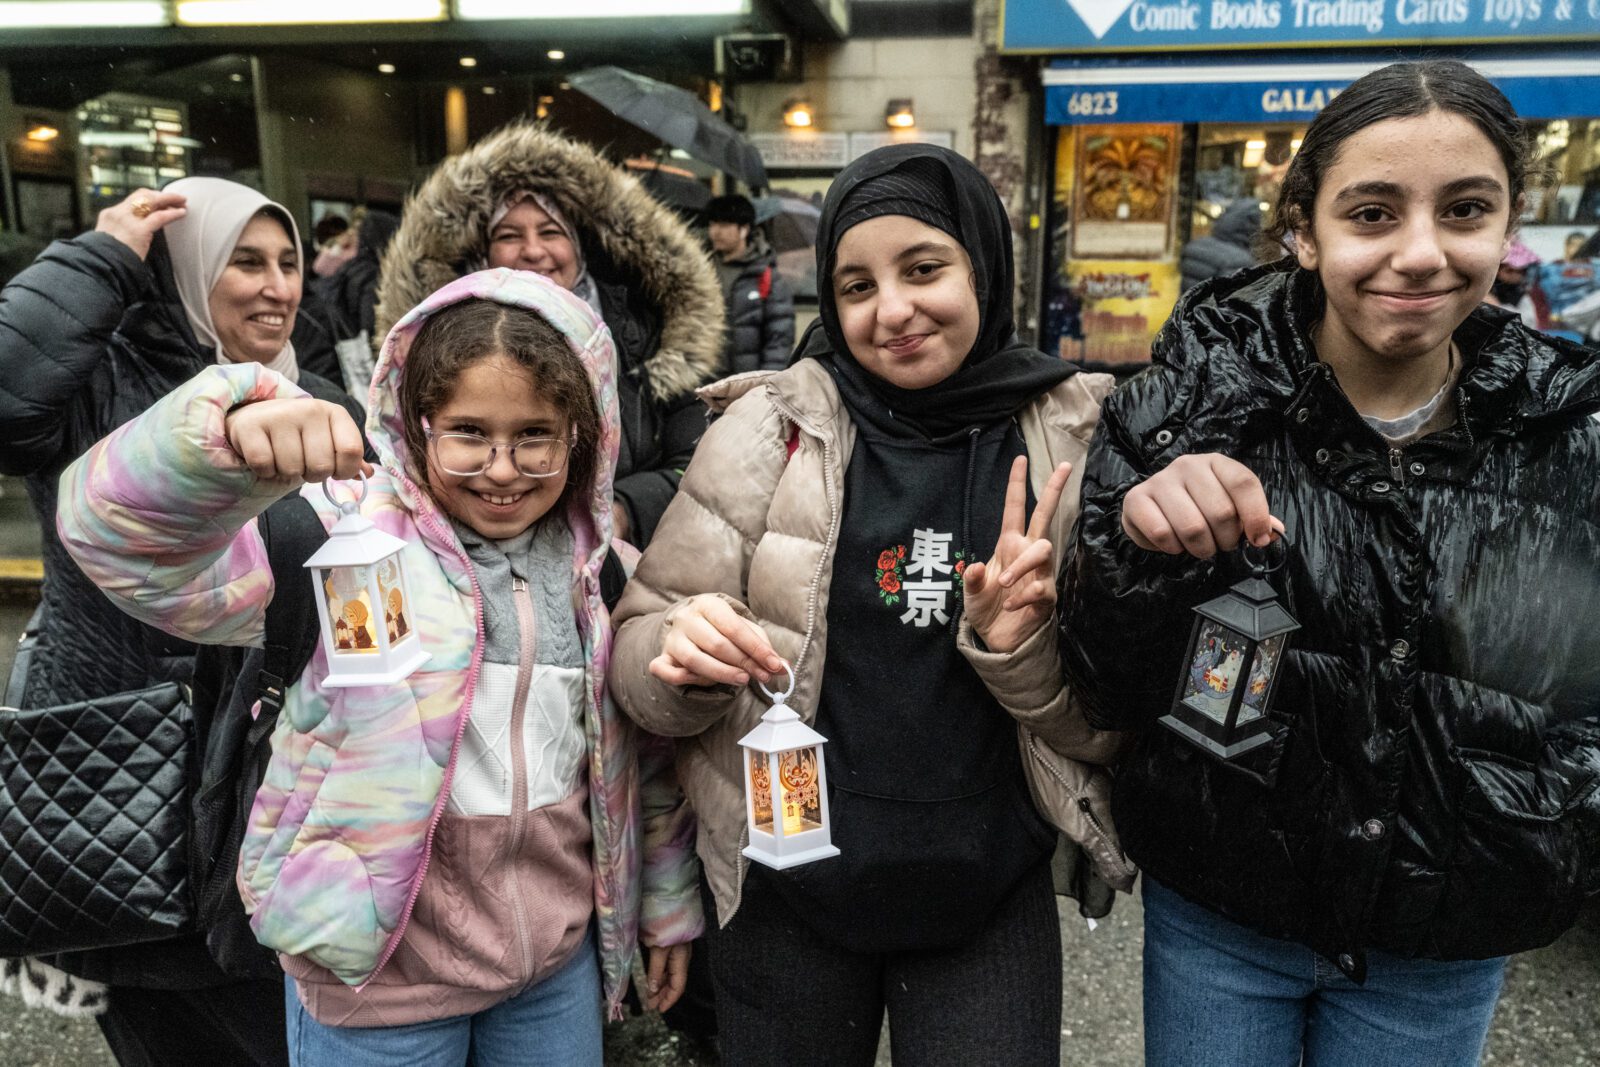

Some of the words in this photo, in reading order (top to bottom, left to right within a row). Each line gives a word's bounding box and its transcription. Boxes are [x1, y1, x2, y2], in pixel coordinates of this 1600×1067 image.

[1129, 0, 1199, 32] Comic
[1210, 0, 1281, 30] Books
[1292, 0, 1384, 33] Trading
[1395, 0, 1469, 25] Cards
[1482, 0, 1542, 29] Toys
[1067, 91, 1119, 116] 6823
[900, 528, 953, 627] 東京
